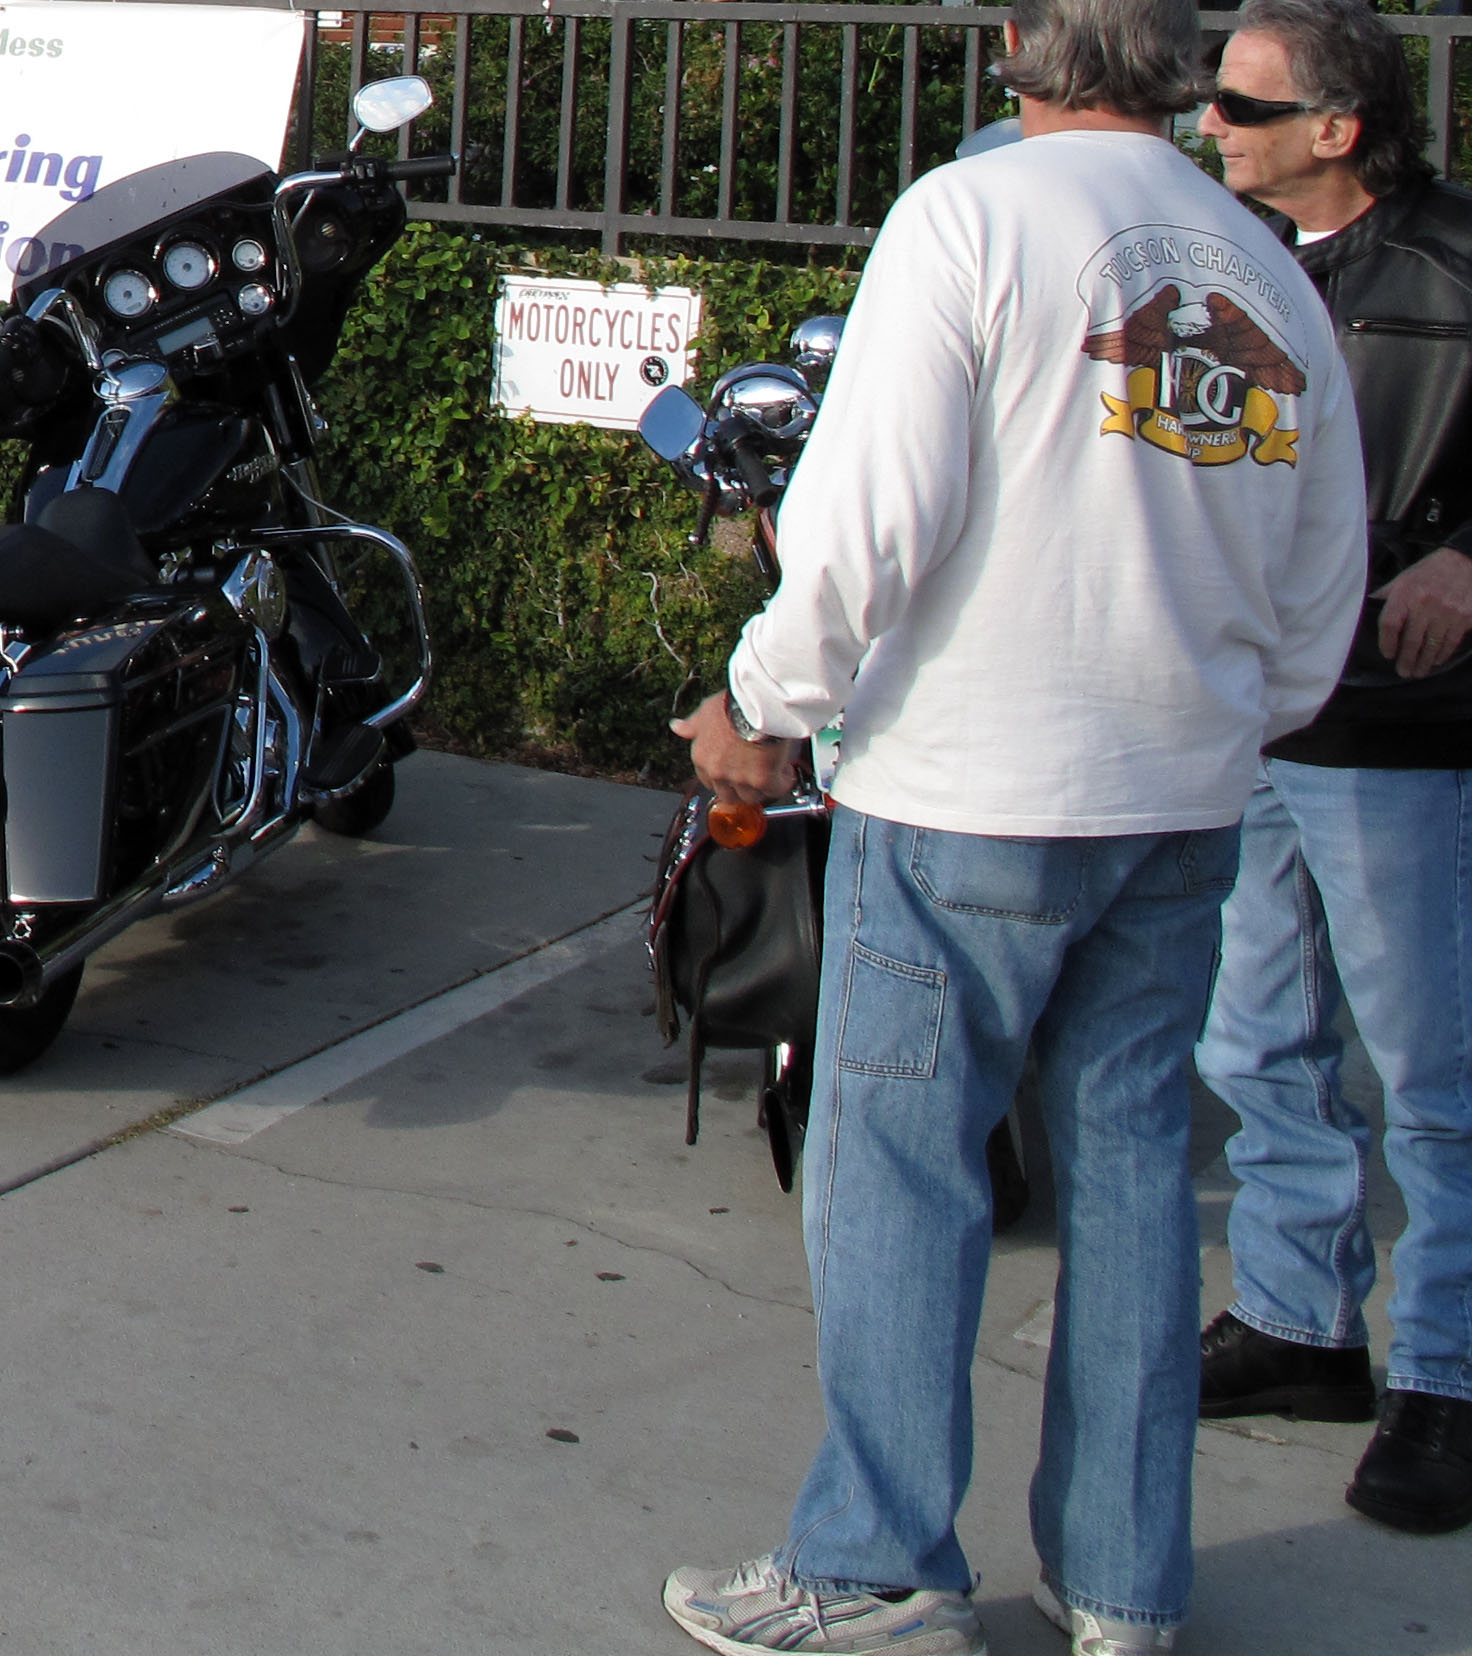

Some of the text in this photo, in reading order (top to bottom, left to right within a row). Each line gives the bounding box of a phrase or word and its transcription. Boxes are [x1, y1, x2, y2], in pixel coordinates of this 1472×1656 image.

[1099, 236, 1291, 323] TUCSON CHAPTER
[508, 301, 681, 353] MOTORCYCLES
[559, 358, 620, 401] ONLY
[1187, 430, 1237, 447] WNERS
